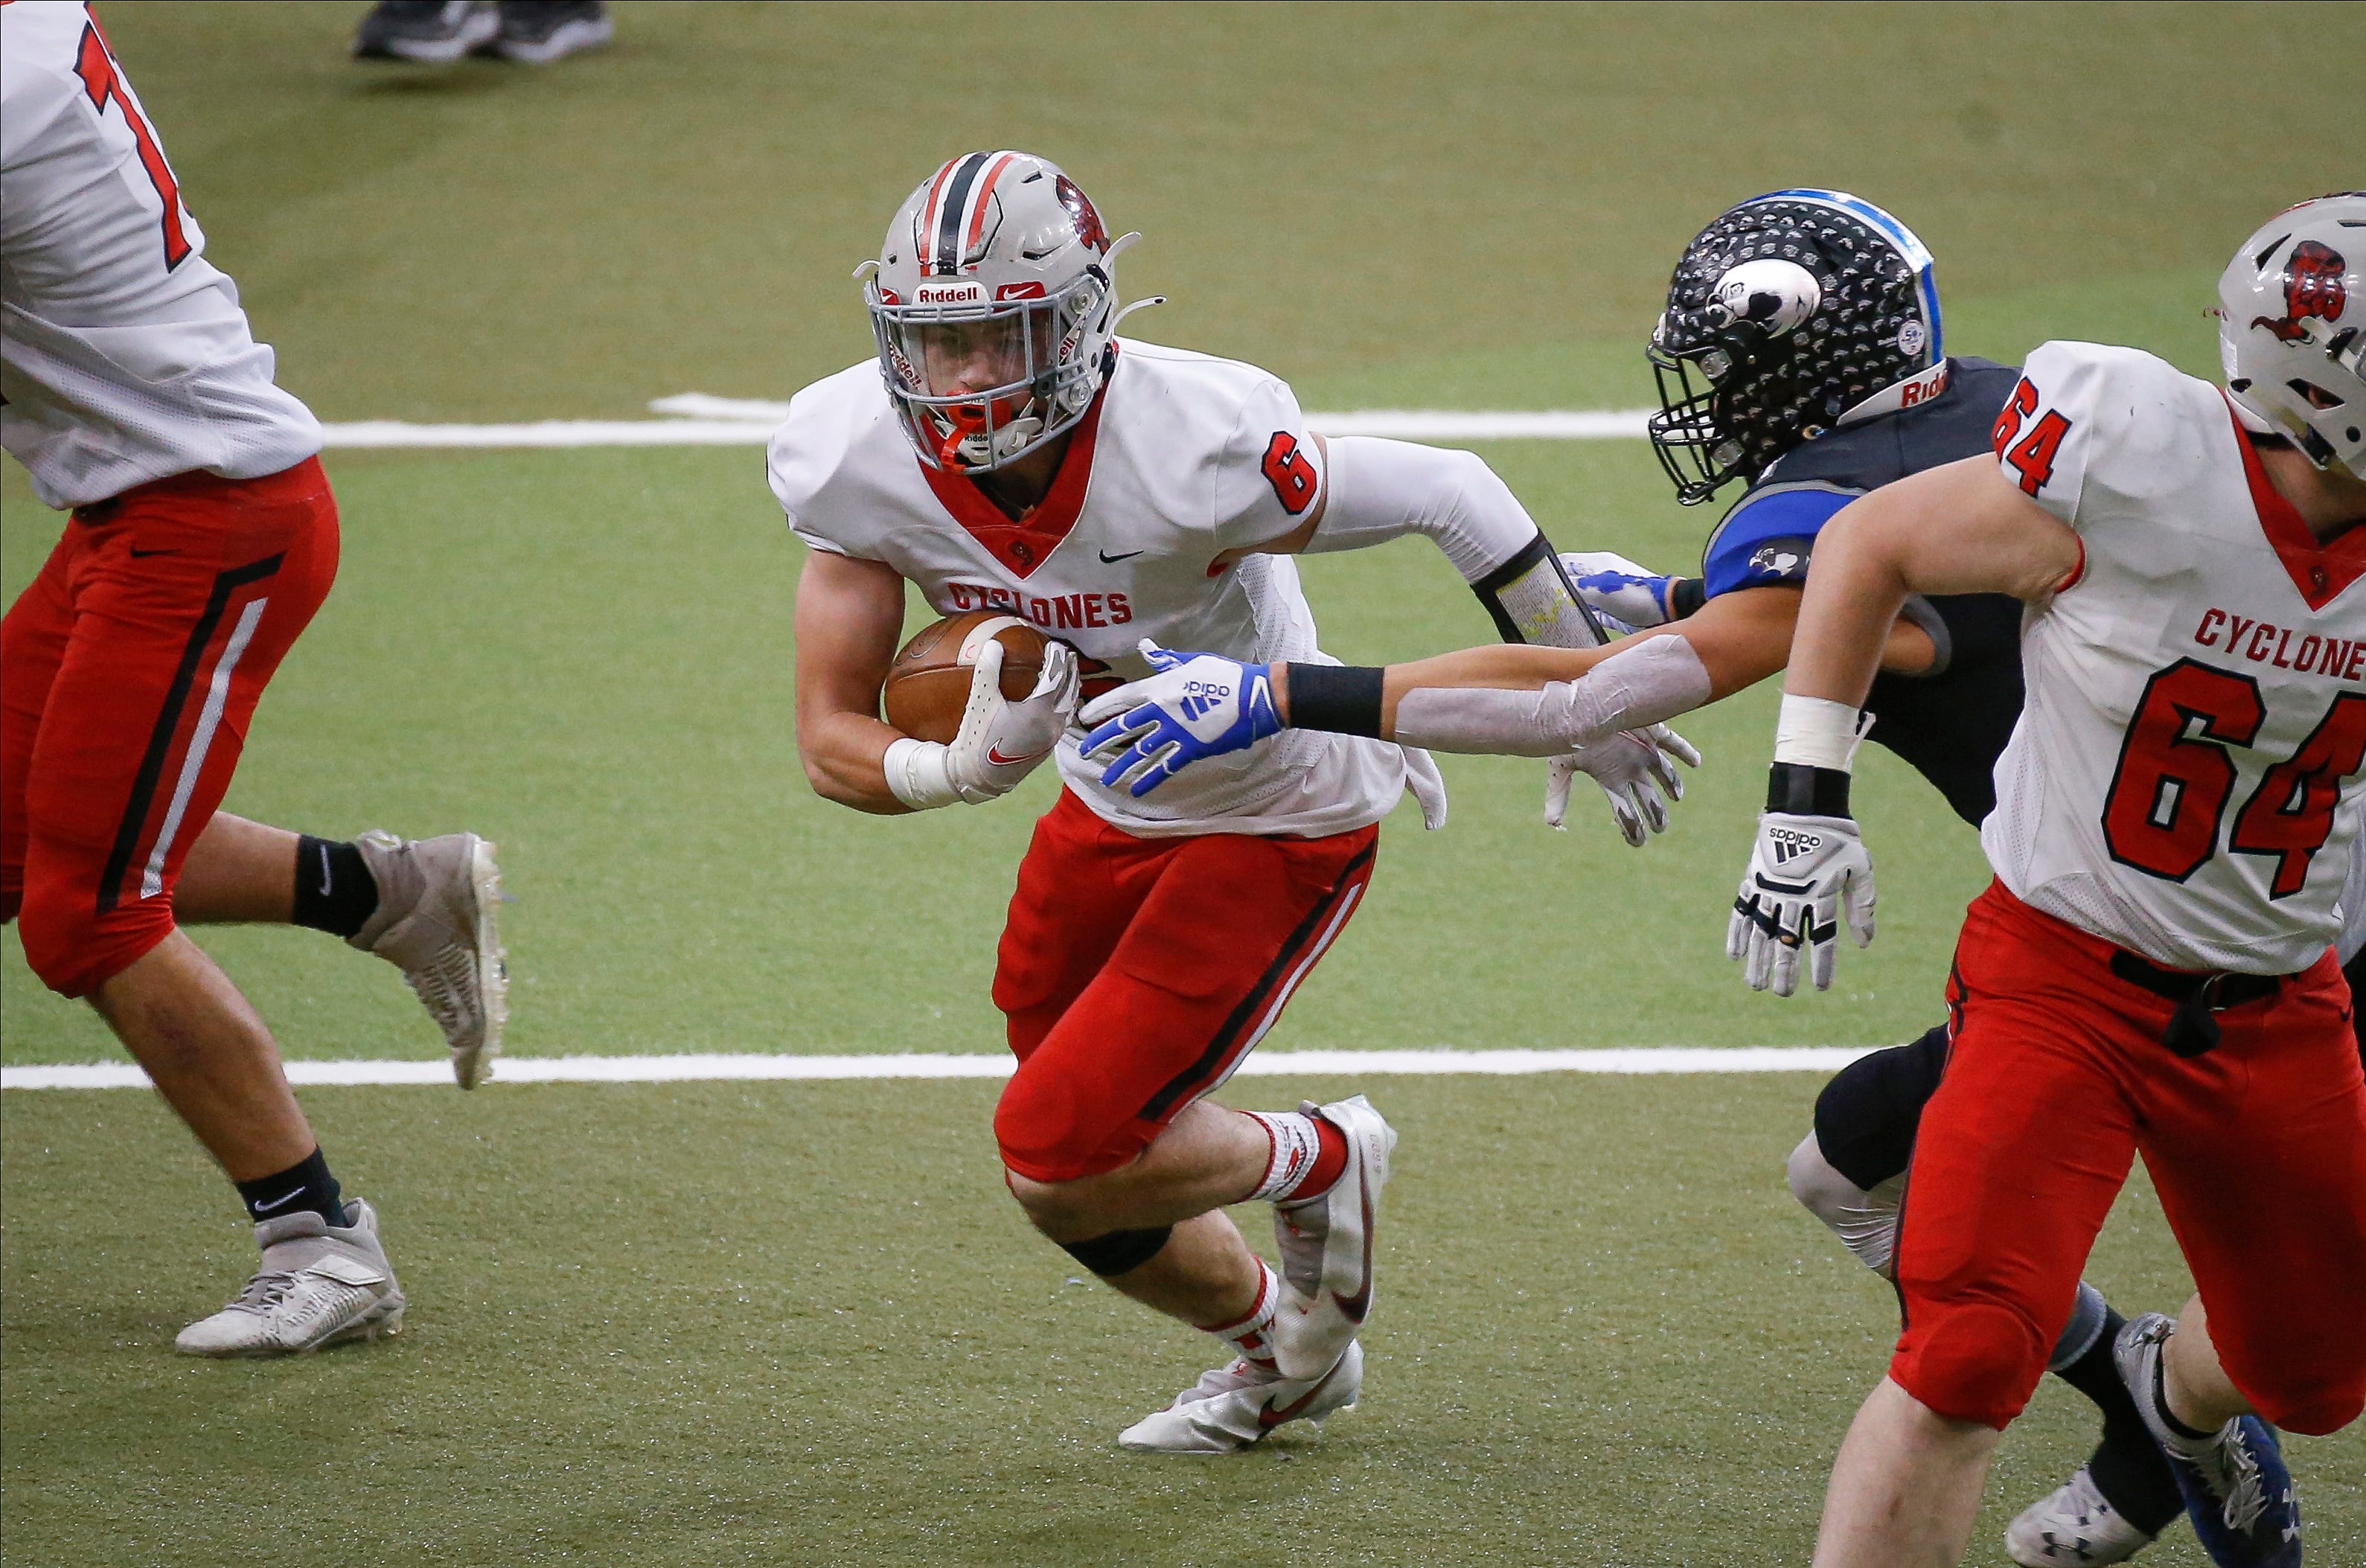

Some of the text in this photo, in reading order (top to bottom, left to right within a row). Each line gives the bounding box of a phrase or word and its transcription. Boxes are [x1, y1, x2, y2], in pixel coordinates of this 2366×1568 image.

[919, 287, 978, 304] Riddell
[1261, 431, 1317, 515] 6
[1992, 376, 2073, 499] 64
[2195, 608, 2365, 681] CYCLONE
[2101, 656, 2365, 900] 64
[1769, 828, 1820, 847] adidas
